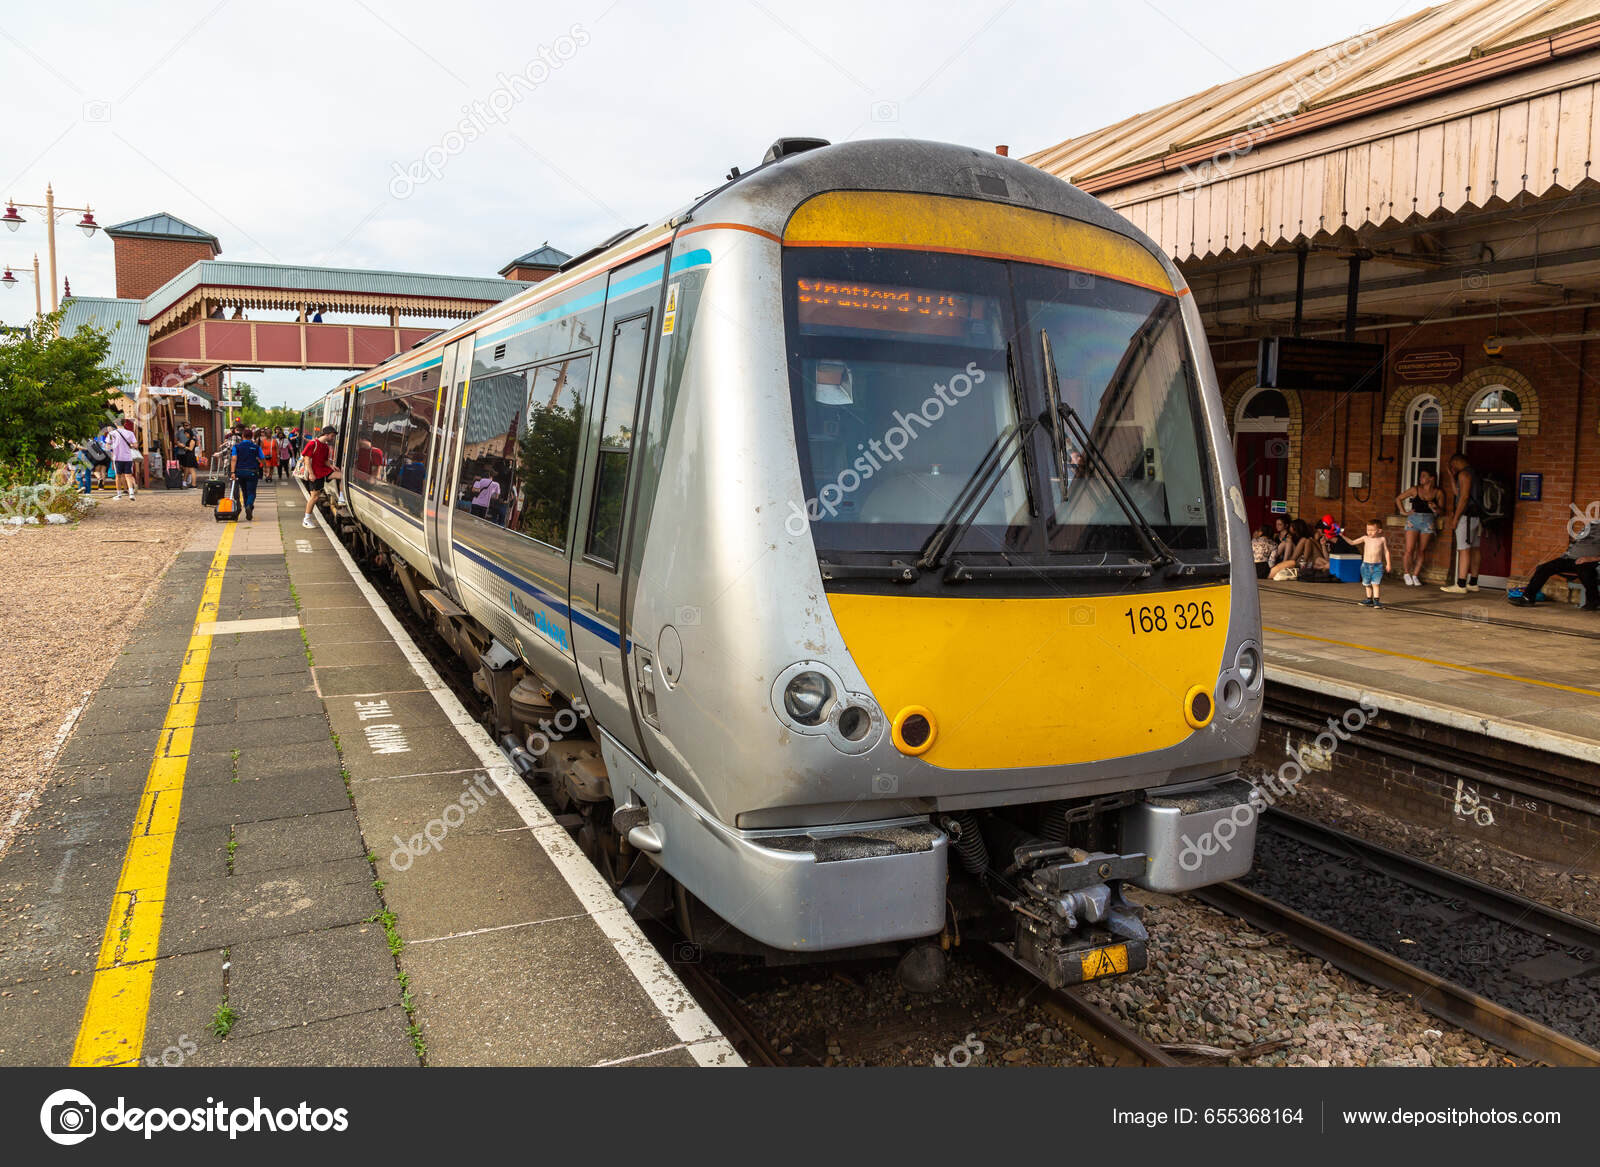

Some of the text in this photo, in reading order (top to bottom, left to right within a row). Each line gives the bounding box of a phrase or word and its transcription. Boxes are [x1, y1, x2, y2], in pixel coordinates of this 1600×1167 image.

[1125, 601, 1214, 635] 168 326
[353, 699, 411, 754] MIND THE
